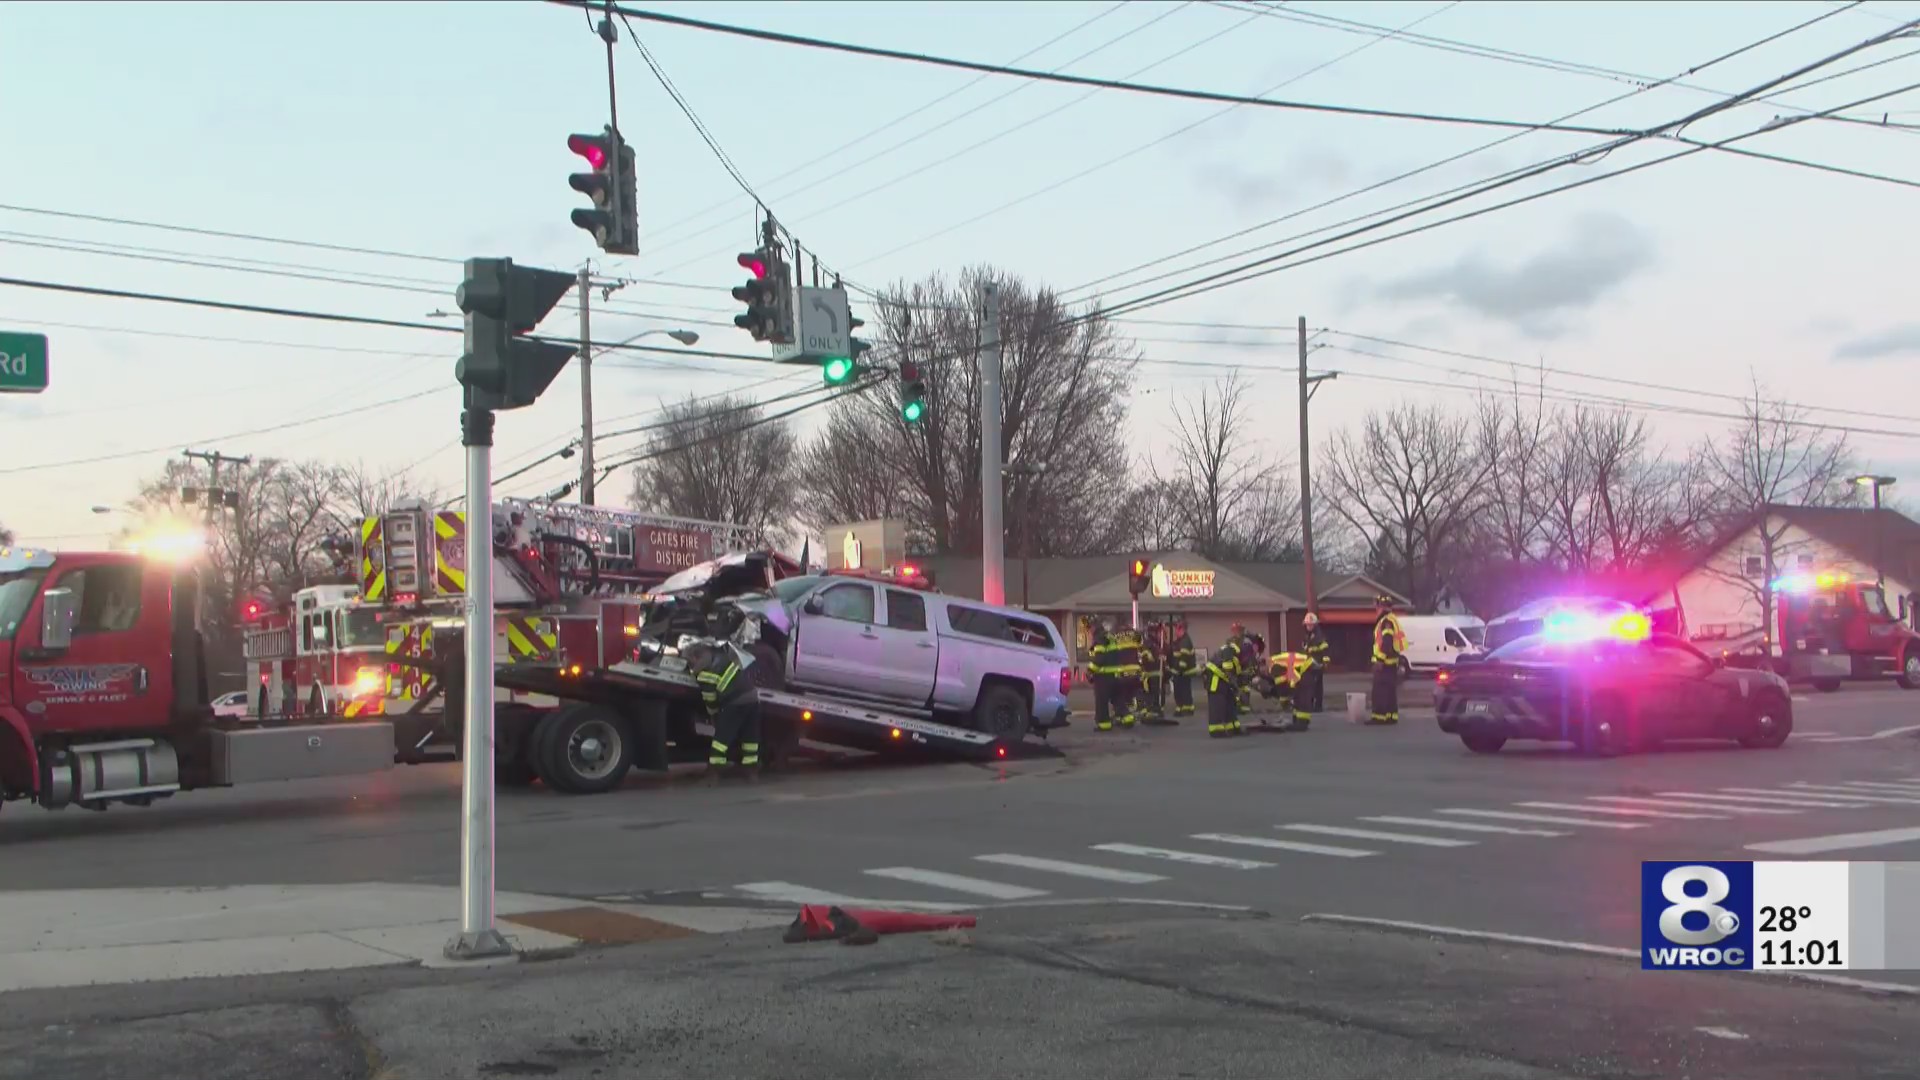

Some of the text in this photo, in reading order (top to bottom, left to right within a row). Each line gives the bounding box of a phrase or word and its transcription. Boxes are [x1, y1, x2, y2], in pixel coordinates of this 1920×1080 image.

[809, 335, 844, 350] ONLY
[0, 351, 27, 376] Rd
[650, 530, 699, 550] GATES FIRE
[656, 550, 697, 567] DISTRICT
[1171, 585, 1213, 596] DONUTS
[53, 681, 108, 692] TOWING
[98, 692, 128, 702] FLEET
